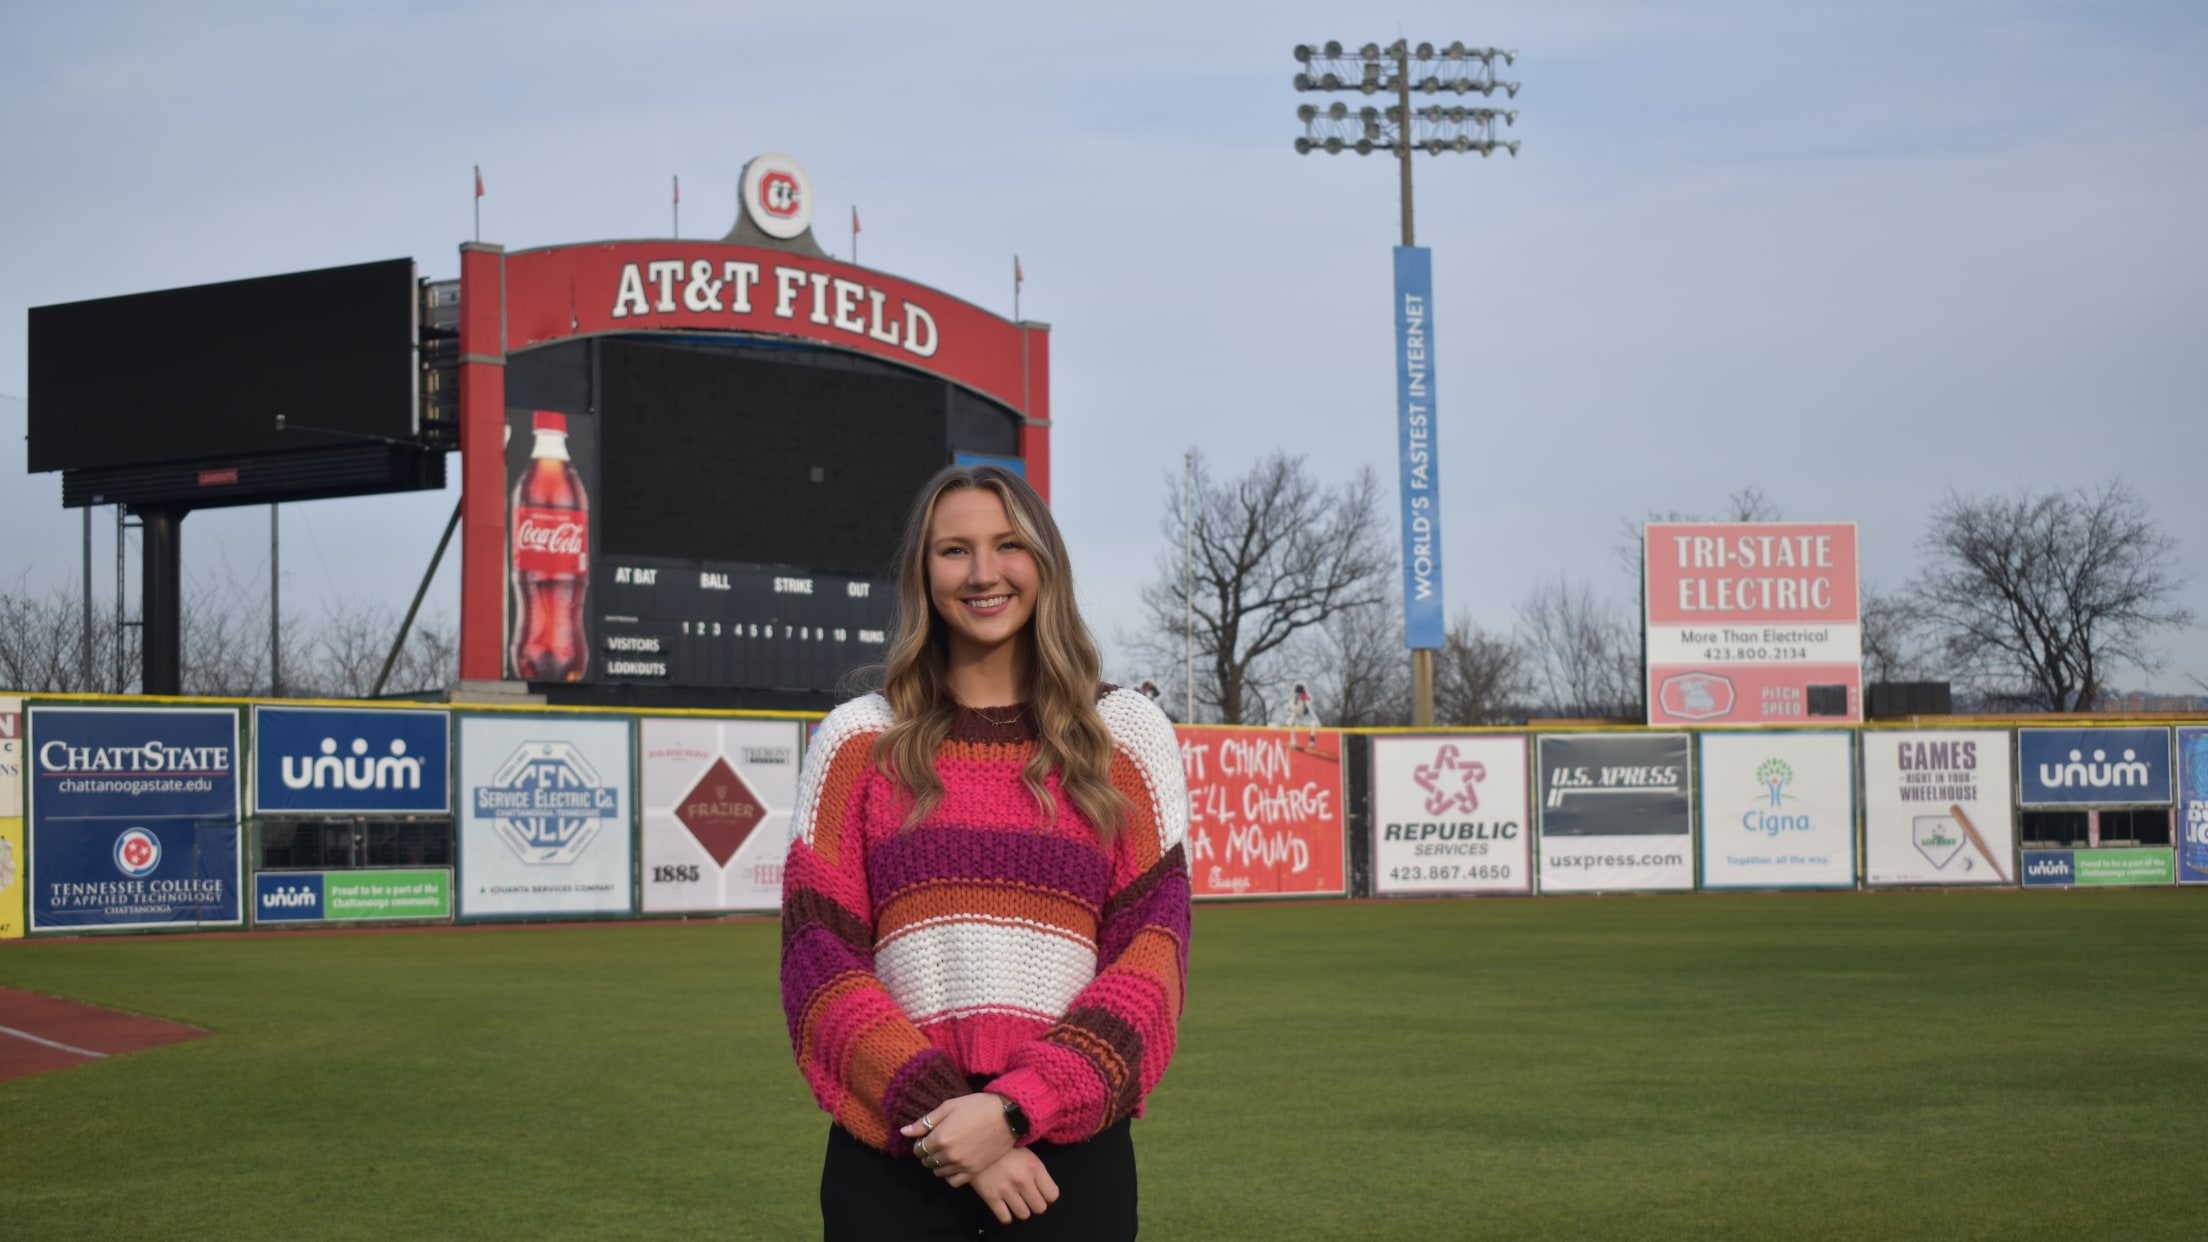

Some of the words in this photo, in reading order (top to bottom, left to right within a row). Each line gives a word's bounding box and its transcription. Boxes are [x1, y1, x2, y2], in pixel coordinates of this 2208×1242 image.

[611, 259, 760, 318] AT&T
[773, 265, 939, 358] FIELD
[1405, 292, 1426, 397] INTERNET
[1409, 403, 1429, 490] FASTEST
[518, 518, 584, 554] Coca-Cola
[1412, 494, 1433, 602] WORLD'S
[1673, 535, 1834, 569] TRI-STATE
[615, 568, 631, 584] AT
[633, 568, 657, 585] BAT
[700, 572, 731, 590] BALL
[773, 577, 814, 594] STRIKE
[847, 582, 870, 597] OUT
[1678, 576, 1832, 611] ELECTRIC
[734, 623, 743, 636] 4
[749, 624, 758, 638] 5
[764, 625, 773, 639] 6
[785, 626, 793, 639] 7
[834, 628, 846, 642] 10
[858, 629, 885, 644] RUNS
[1681, 630, 1717, 644] More
[1722, 629, 1758, 643] Than
[1763, 629, 1828, 643] Electrical
[607, 637, 660, 652] VISITORS
[1703, 647, 1807, 660] 423.800.2134
[607, 661, 666, 676] LOOKOUTS
[1761, 686, 1799, 699] PITCH
[1761, 702, 1801, 716] SPEED
[281, 738, 422, 789] unum
[1181, 738, 1209, 781] AT
[1219, 738, 1291, 784] CHIKIN
[1898, 741, 1977, 771] GAMES
[1551, 767, 1593, 787] U.S.
[1599, 766, 1677, 786] XPRESS
[2039, 749, 2149, 788] unum
[59, 777, 212, 795] chattanoogastate.edu
[1906, 772, 1932, 784] RIGHT
[1935, 772, 1944, 784] IN
[1948, 772, 1970, 784] YOUR
[1899, 784, 1978, 801] WHEELHOUSE
[687, 801, 755, 818] FRAZIER
[1189, 782, 1235, 825] E'LL
[1242, 781, 1333, 824] CHARGE
[1384, 821, 1519, 841] REPUBLIC
[1742, 810, 1810, 837] Cigna
[1225, 822, 1310, 874] MOUND
[1414, 843, 1489, 857] SERVICES
[1550, 851, 1683, 870] usxpress.com
[2028, 860, 2069, 876] unum
[653, 864, 700, 883] 1885
[1389, 865, 1512, 881] 423.867.4650
[51, 880, 145, 896] TENNESSEE
[150, 879, 223, 893] COLLEGE
[262, 886, 316, 907] unum
[360, 886, 370, 895] to
[372, 885, 382, 895] be
[51, 896, 68, 907] OF
[73, 894, 128, 906] APPLIED
[134, 891, 223, 905] TECHNOLOGY
[104, 905, 172, 915] CHATTANOOGA
